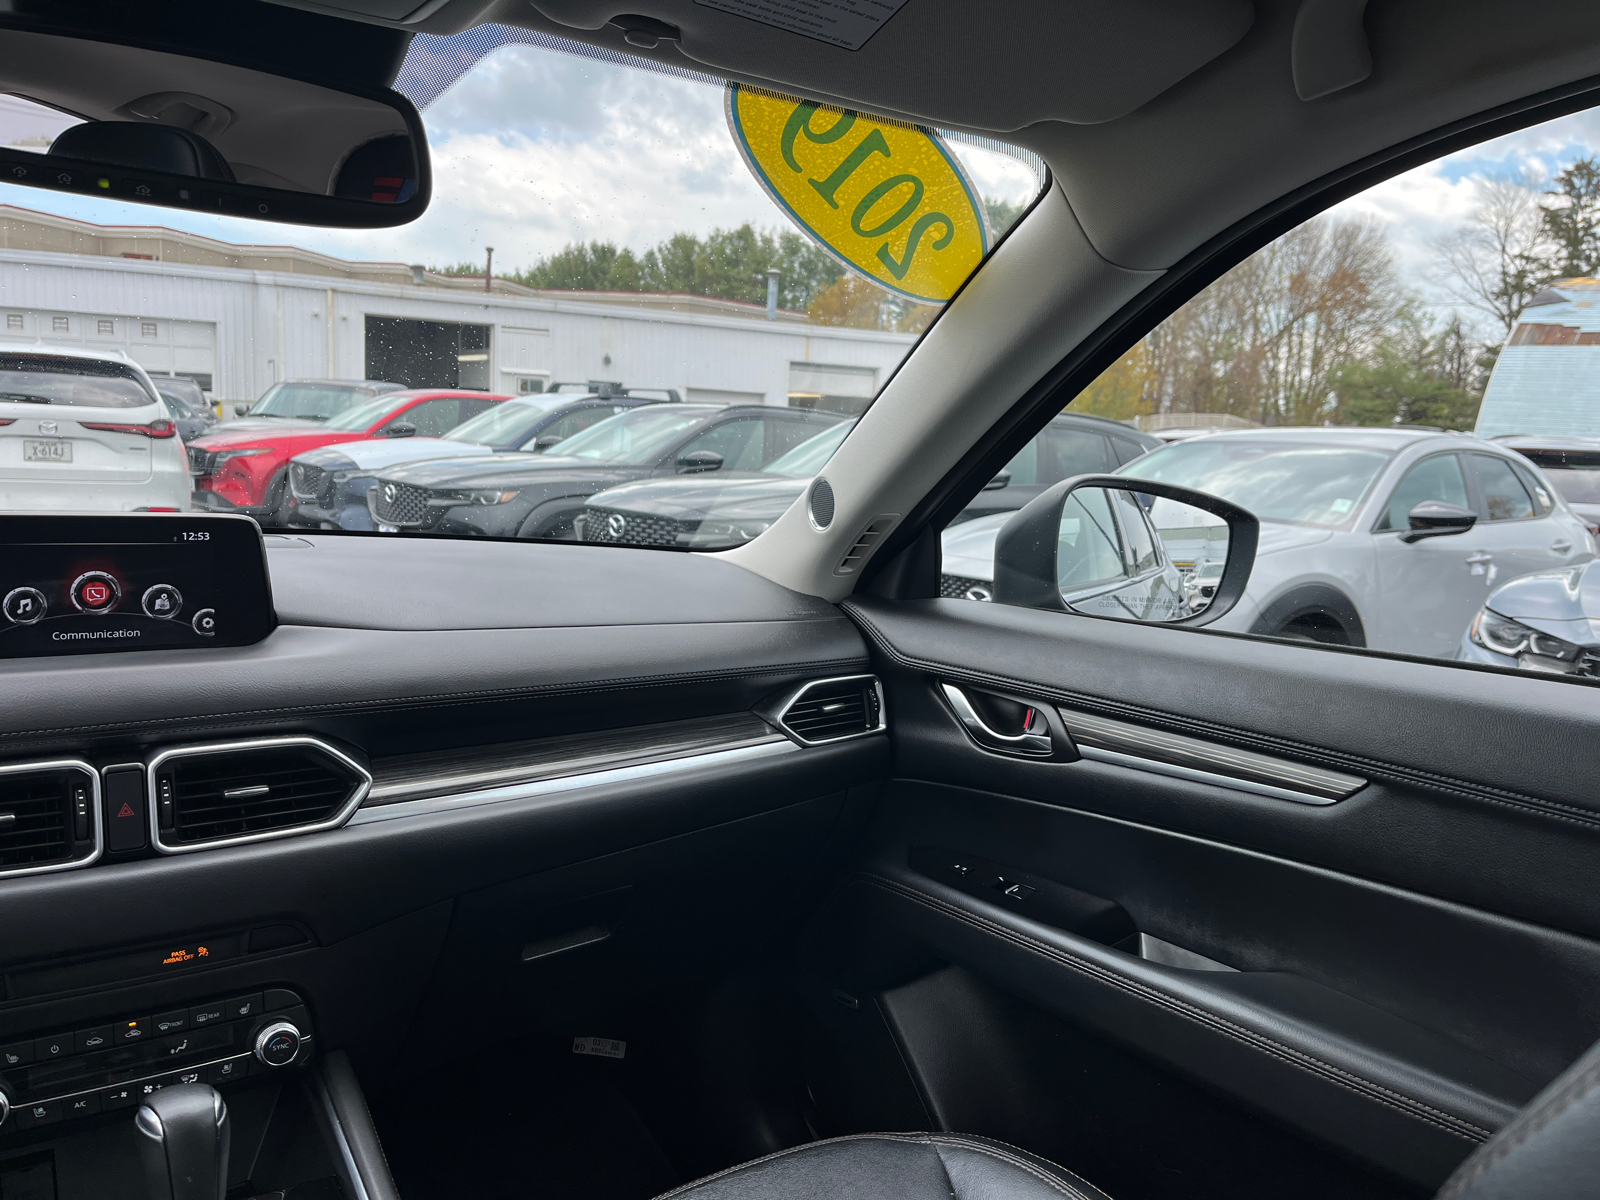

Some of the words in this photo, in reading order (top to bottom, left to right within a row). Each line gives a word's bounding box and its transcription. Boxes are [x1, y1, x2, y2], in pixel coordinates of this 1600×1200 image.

[798, 0, 820, 10] children
[870, 0, 895, 11] seriously
[849, 9, 866, 17] safest
[719, 3, 741, 11] owner's
[742, 9, 762, 17] manual
[786, 23, 816, 35] information
[797, 17, 823, 28] restraints
[182, 532, 210, 541] 12:53
[52, 628, 141, 641] Communication
[272, 1042, 290, 1051] SYNC
[74, 1100, 87, 1108] A/C
